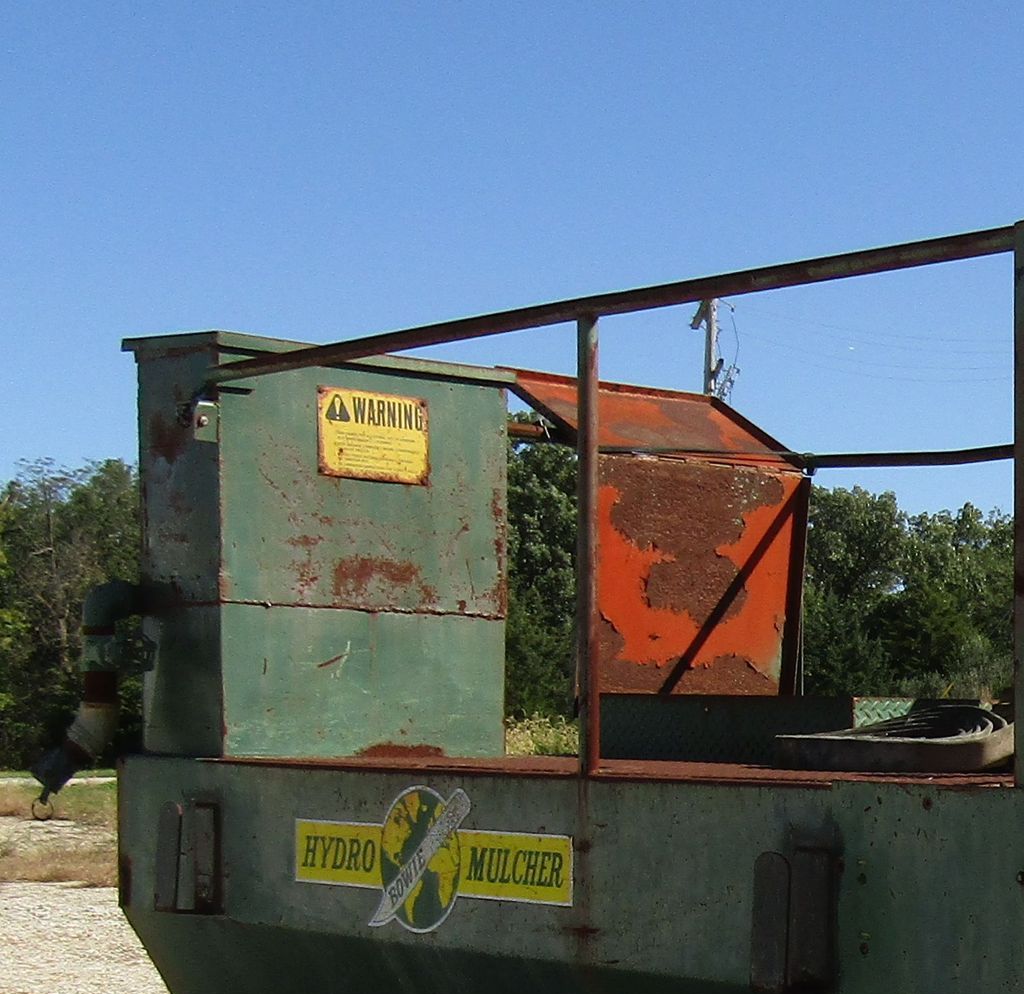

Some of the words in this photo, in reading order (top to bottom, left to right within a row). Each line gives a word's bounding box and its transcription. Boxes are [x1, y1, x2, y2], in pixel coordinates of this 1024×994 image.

[352, 396, 423, 431] WARNING
[302, 835, 375, 873] HYDRO
[466, 846, 564, 889] MULCHER
[388, 848, 427, 906] BOWIE
